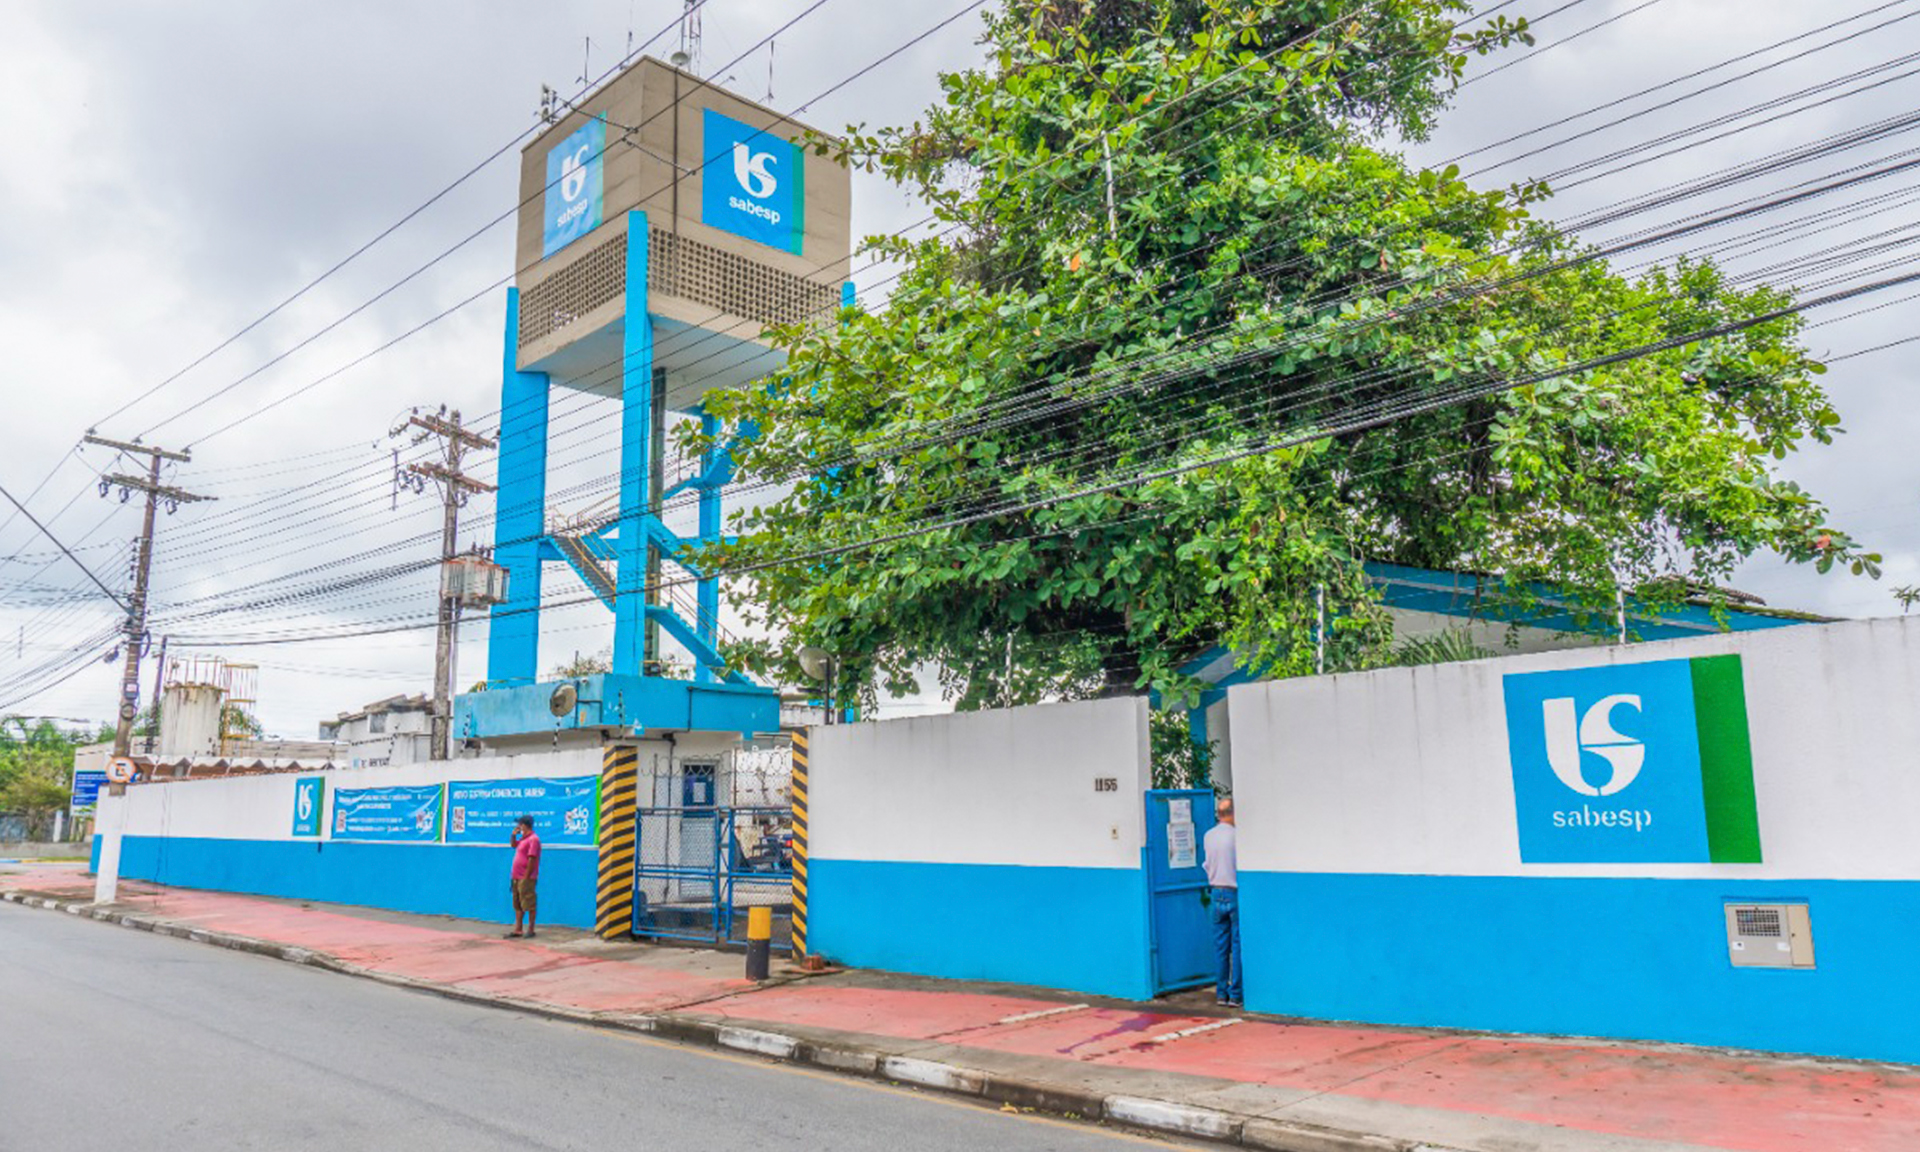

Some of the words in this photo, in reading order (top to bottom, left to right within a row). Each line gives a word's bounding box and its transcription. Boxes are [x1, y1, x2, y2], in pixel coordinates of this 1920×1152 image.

[556, 198, 588, 227] sabesp
[729, 196, 781, 225] sabesp
[1095, 778, 1118, 792] 1155
[1552, 803, 1652, 832] sabesp
